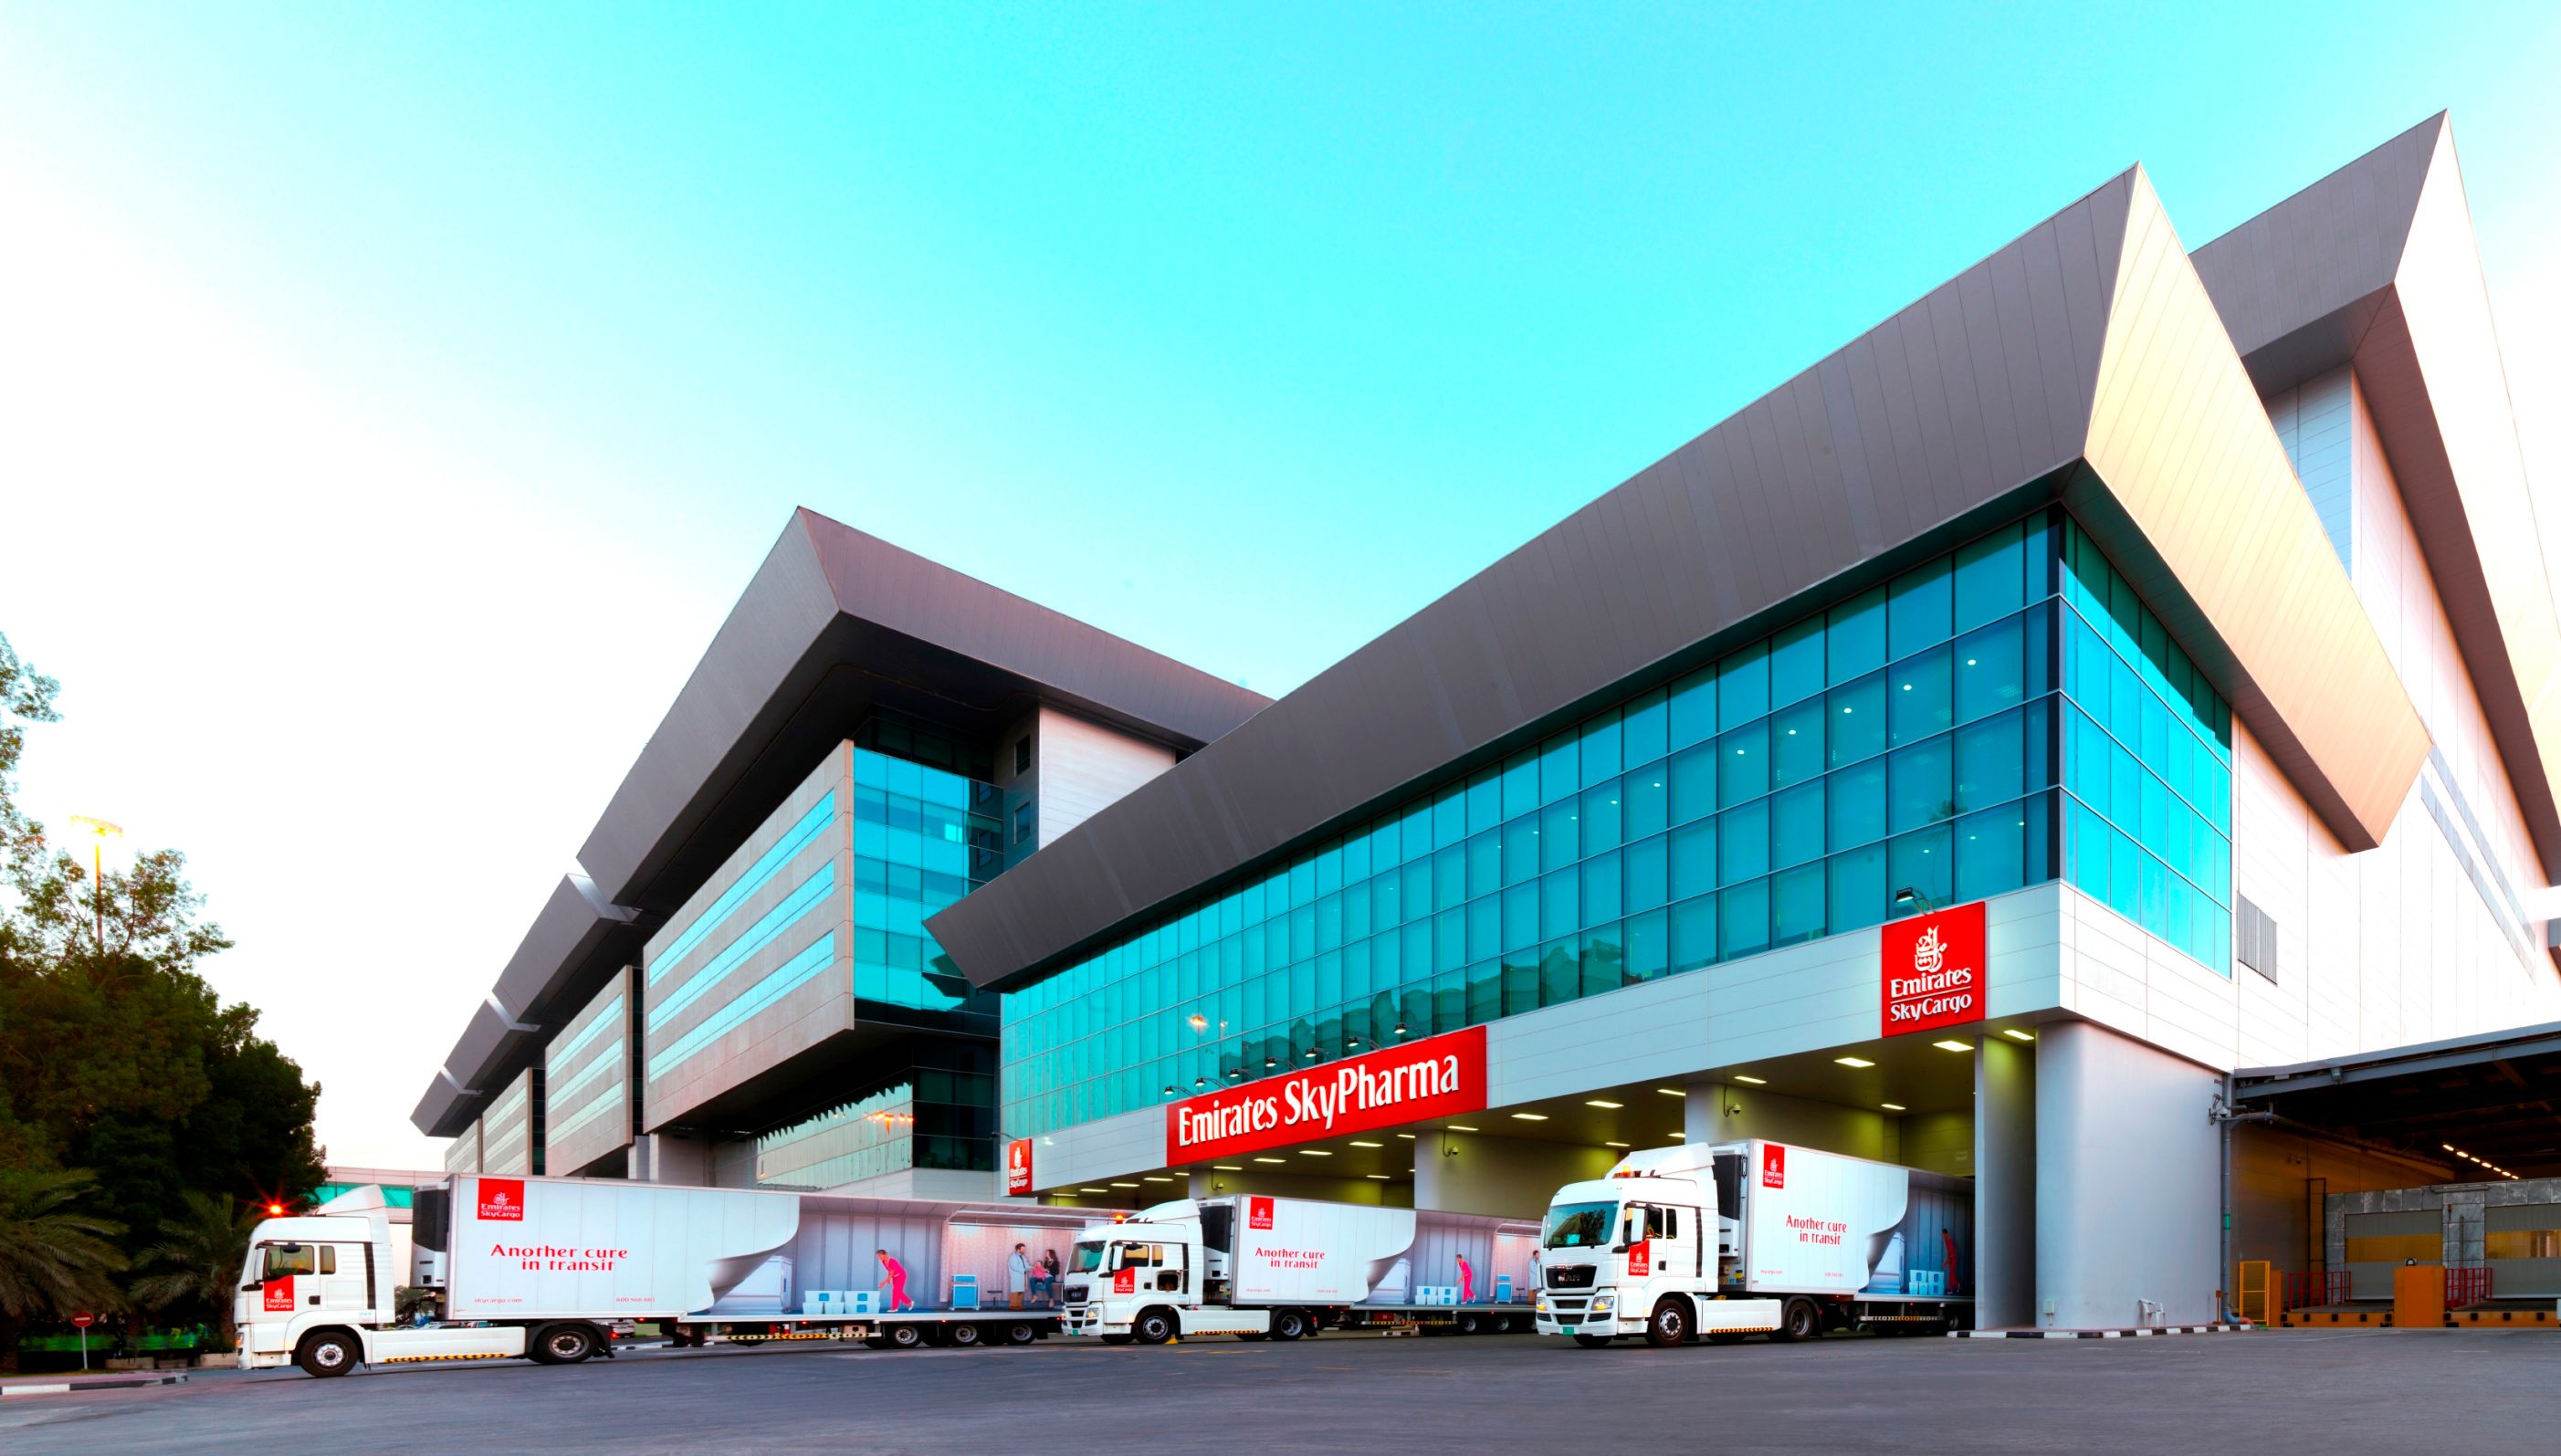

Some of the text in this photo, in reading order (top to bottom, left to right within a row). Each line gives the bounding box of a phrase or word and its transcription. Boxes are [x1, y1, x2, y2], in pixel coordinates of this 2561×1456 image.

[1890, 968, 1972, 998] Emirates
[1890, 993, 1972, 1021] SkyCargo
[1179, 1054, 1459, 1147] Emirates SkyPharma
[480, 1203, 520, 1211] Emirates
[480, 1210, 520, 1219] SkyCargo
[1786, 1214, 1848, 1233] Another cure
[1800, 1230, 1842, 1245] in transit
[490, 1244, 628, 1259] Another cure
[1255, 1247, 1326, 1260] Another cure
[521, 1258, 614, 1272] in transit
[1270, 1258, 1318, 1269] in transit
